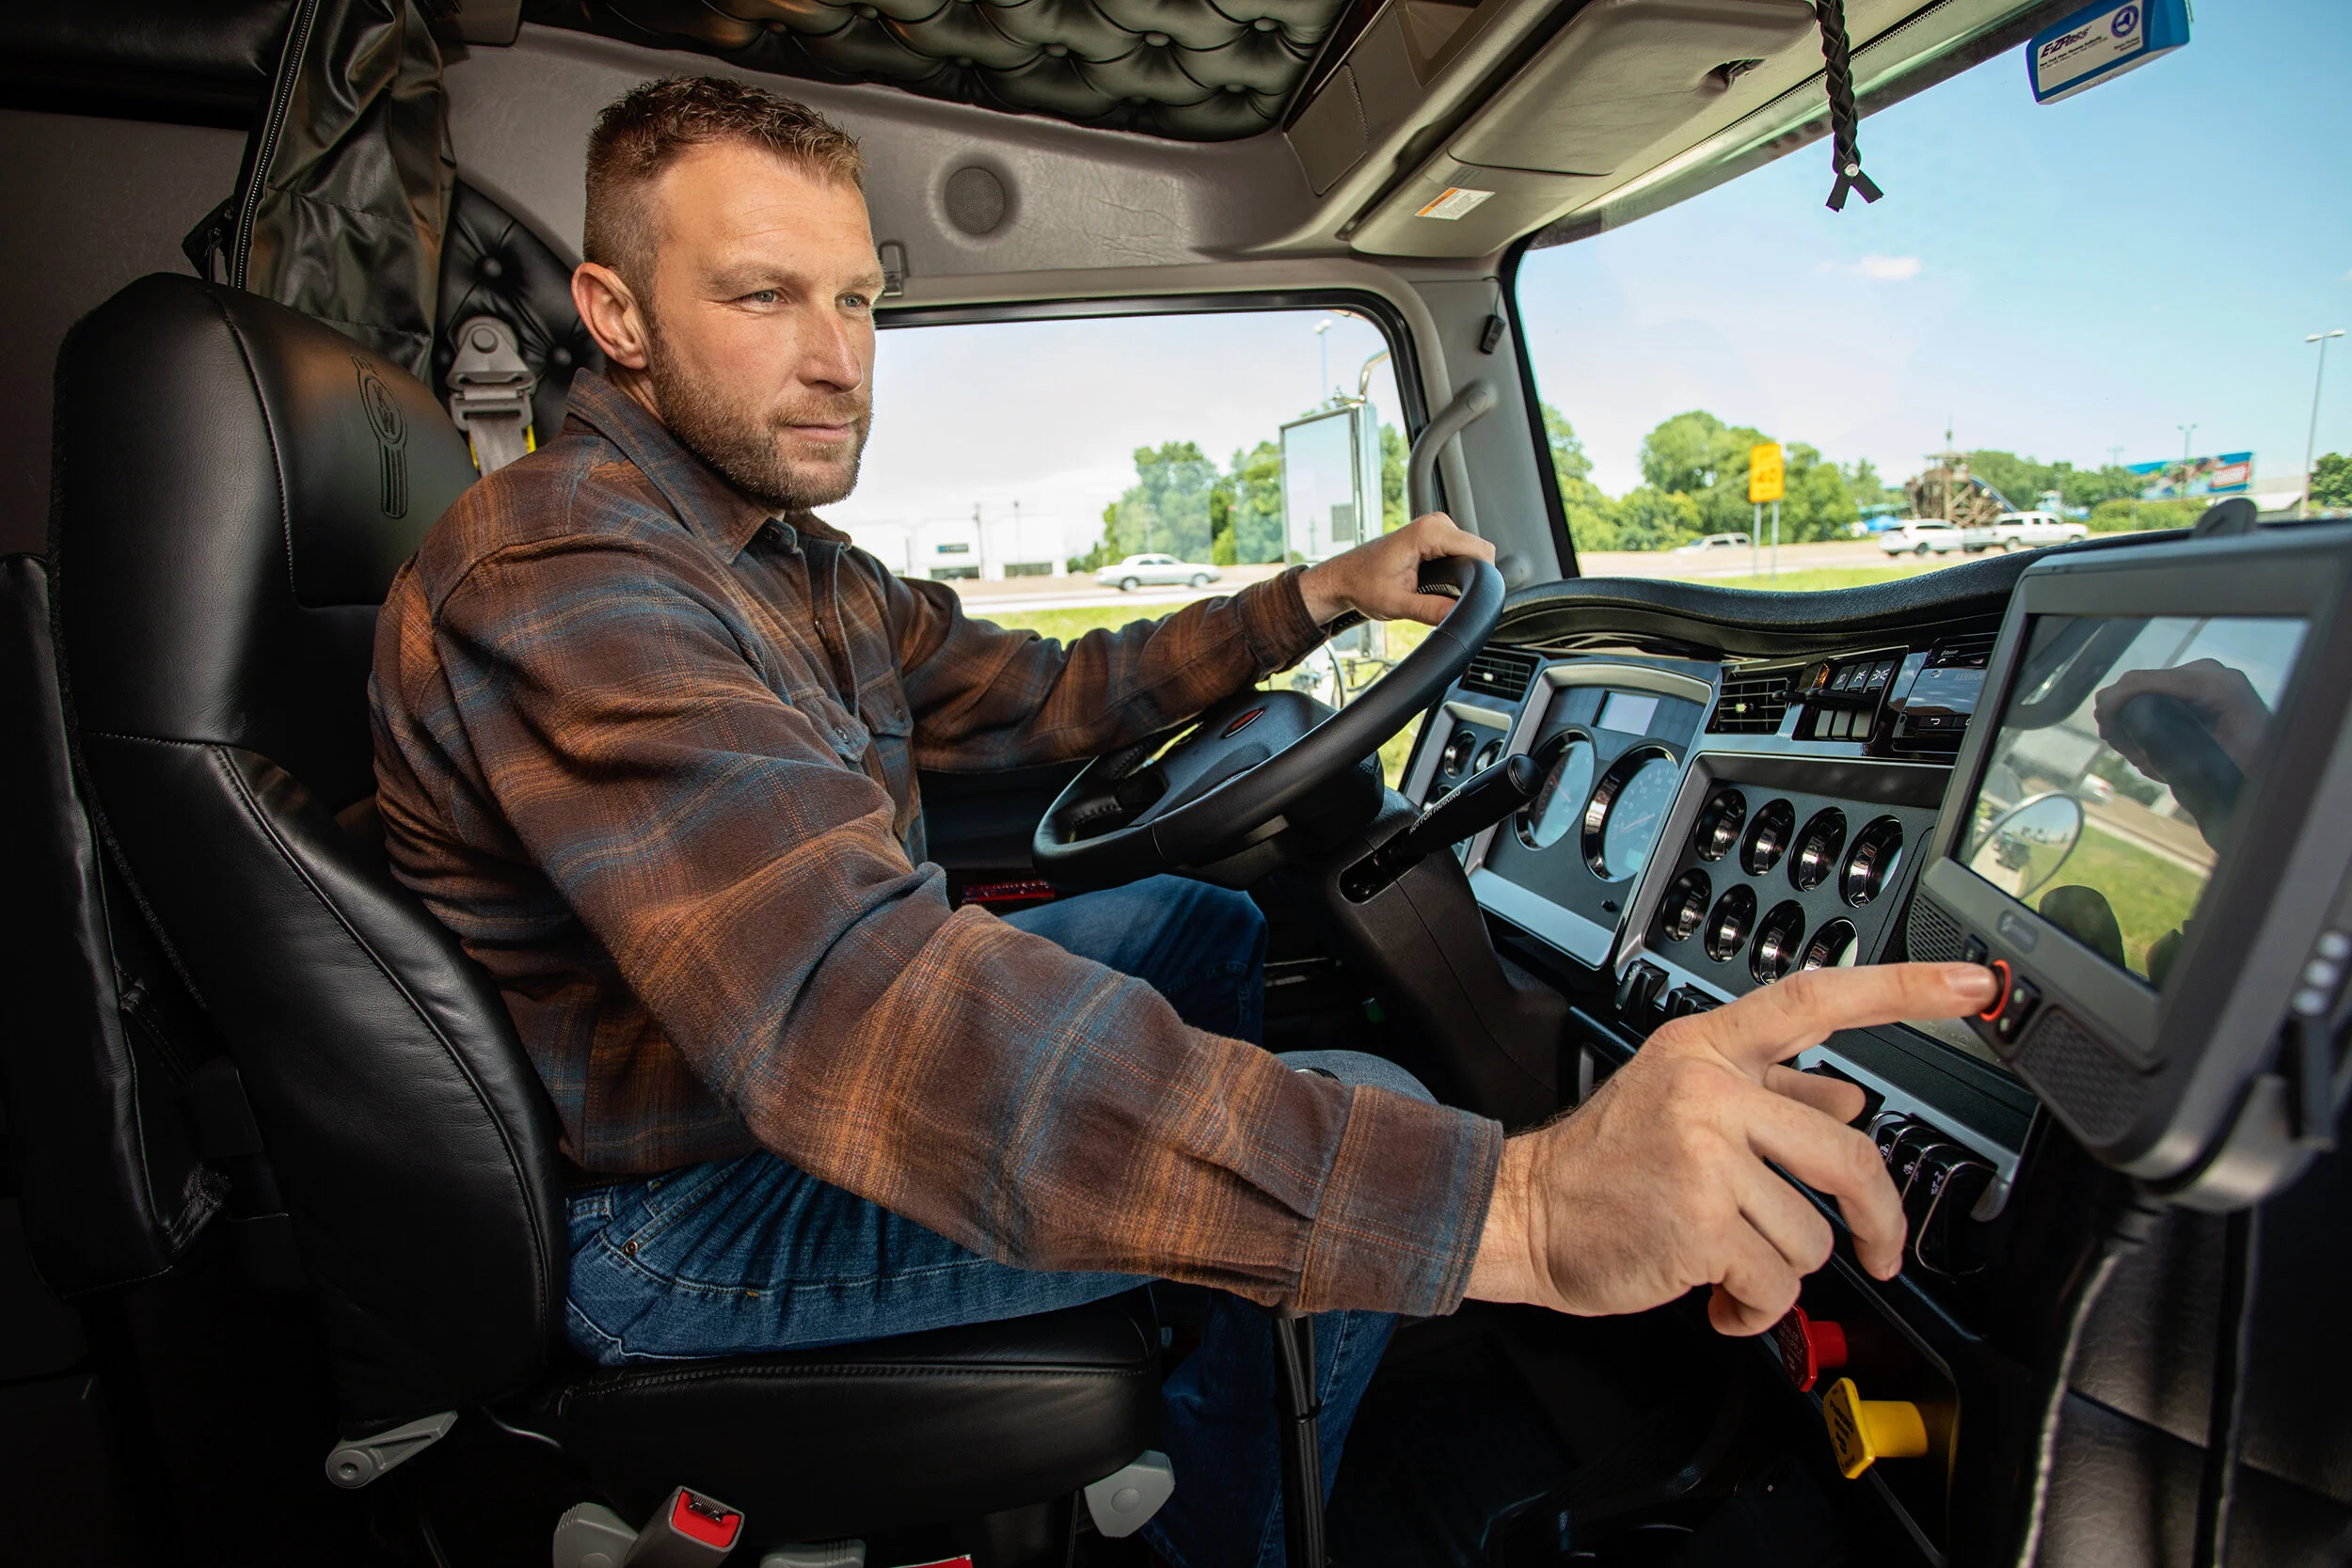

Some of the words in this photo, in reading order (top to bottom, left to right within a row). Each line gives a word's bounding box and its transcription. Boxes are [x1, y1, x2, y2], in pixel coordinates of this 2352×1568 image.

[2040, 30, 2089, 58] E-ZPass
[1421, 809, 1433, 824] FOR
[1434, 788, 1461, 814] PARKING
